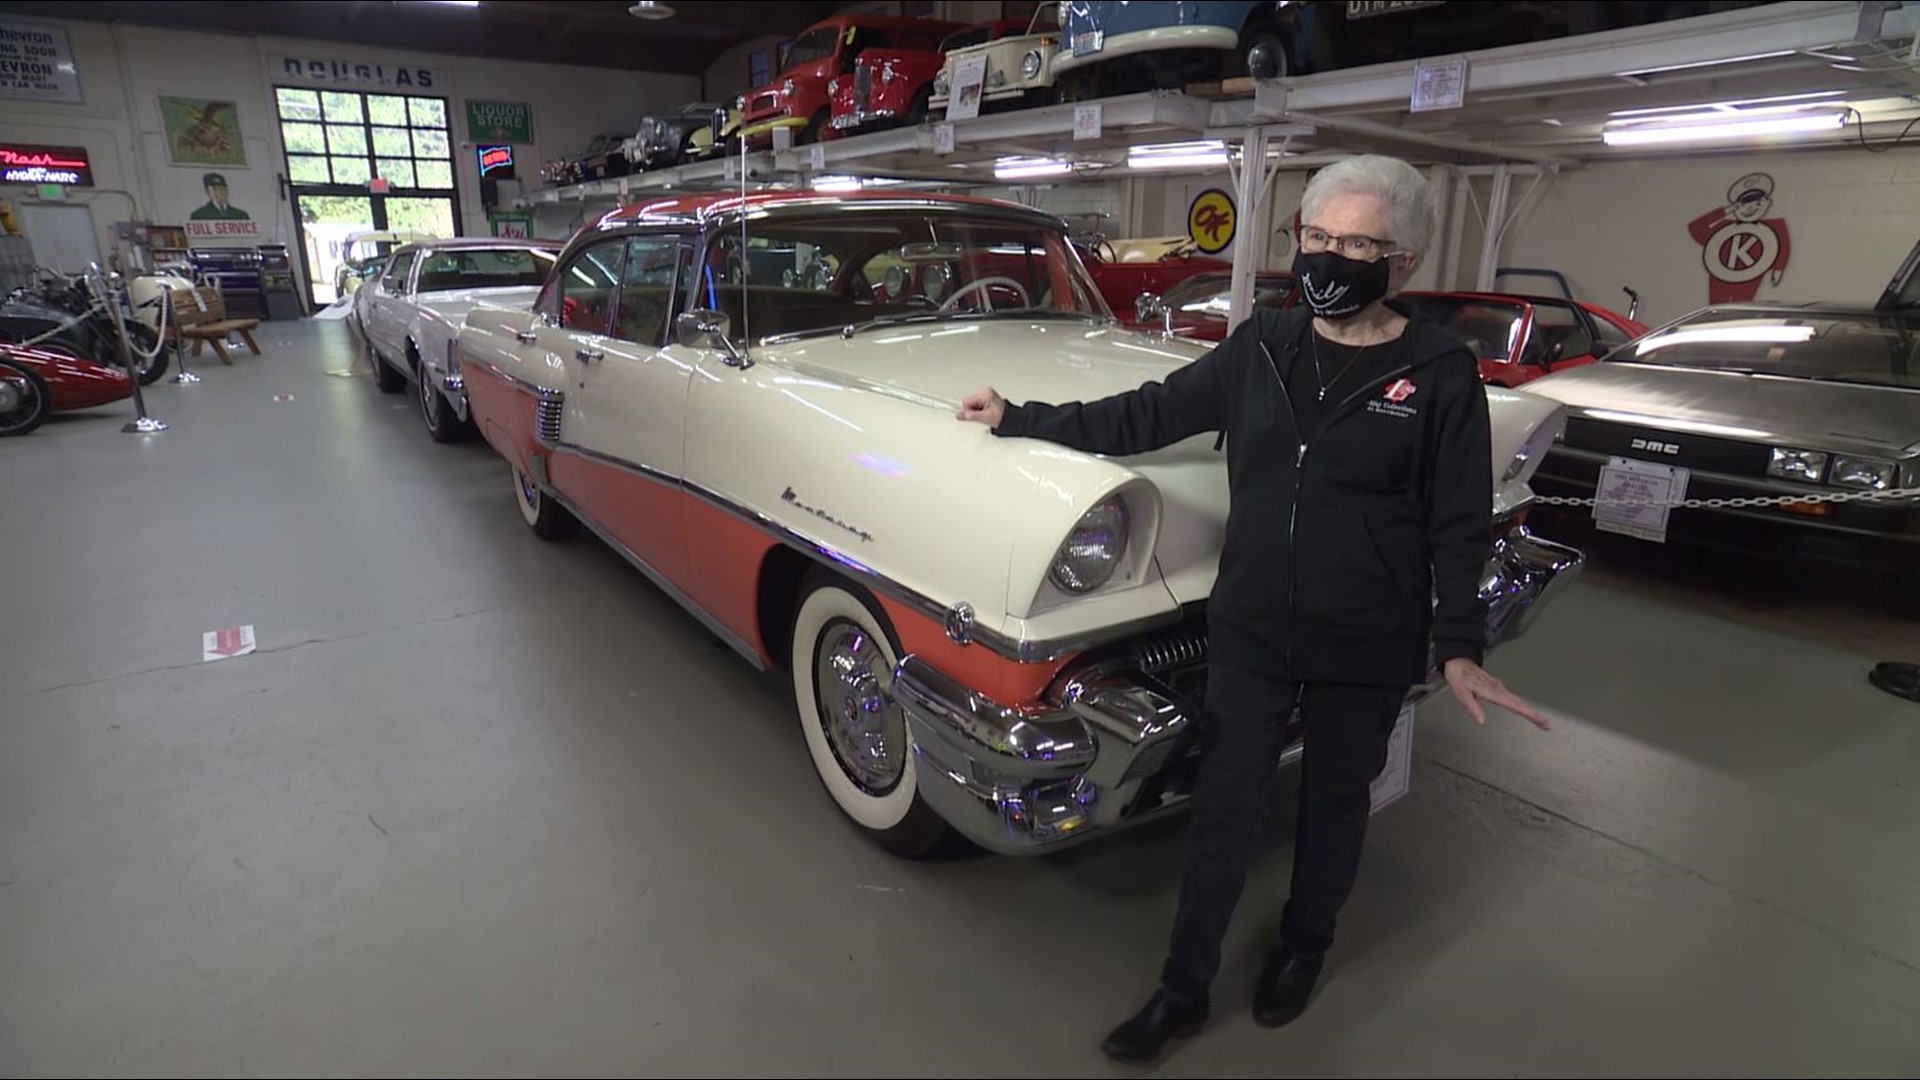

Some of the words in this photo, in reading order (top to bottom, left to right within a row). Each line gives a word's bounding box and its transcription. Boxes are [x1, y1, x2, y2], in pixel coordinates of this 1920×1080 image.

[23, 44, 57, 57] SOON
[283, 58, 434, 88] DOUGLAS
[471, 102, 526, 118] LIQUOR
[476, 114, 524, 128] STORE
[185, 222, 213, 235] FULL
[214, 221, 259, 235] SERVICE
[1194, 204, 1230, 243] OK
[1727, 234, 1759, 270] K
[1630, 438, 1680, 454] DMC
